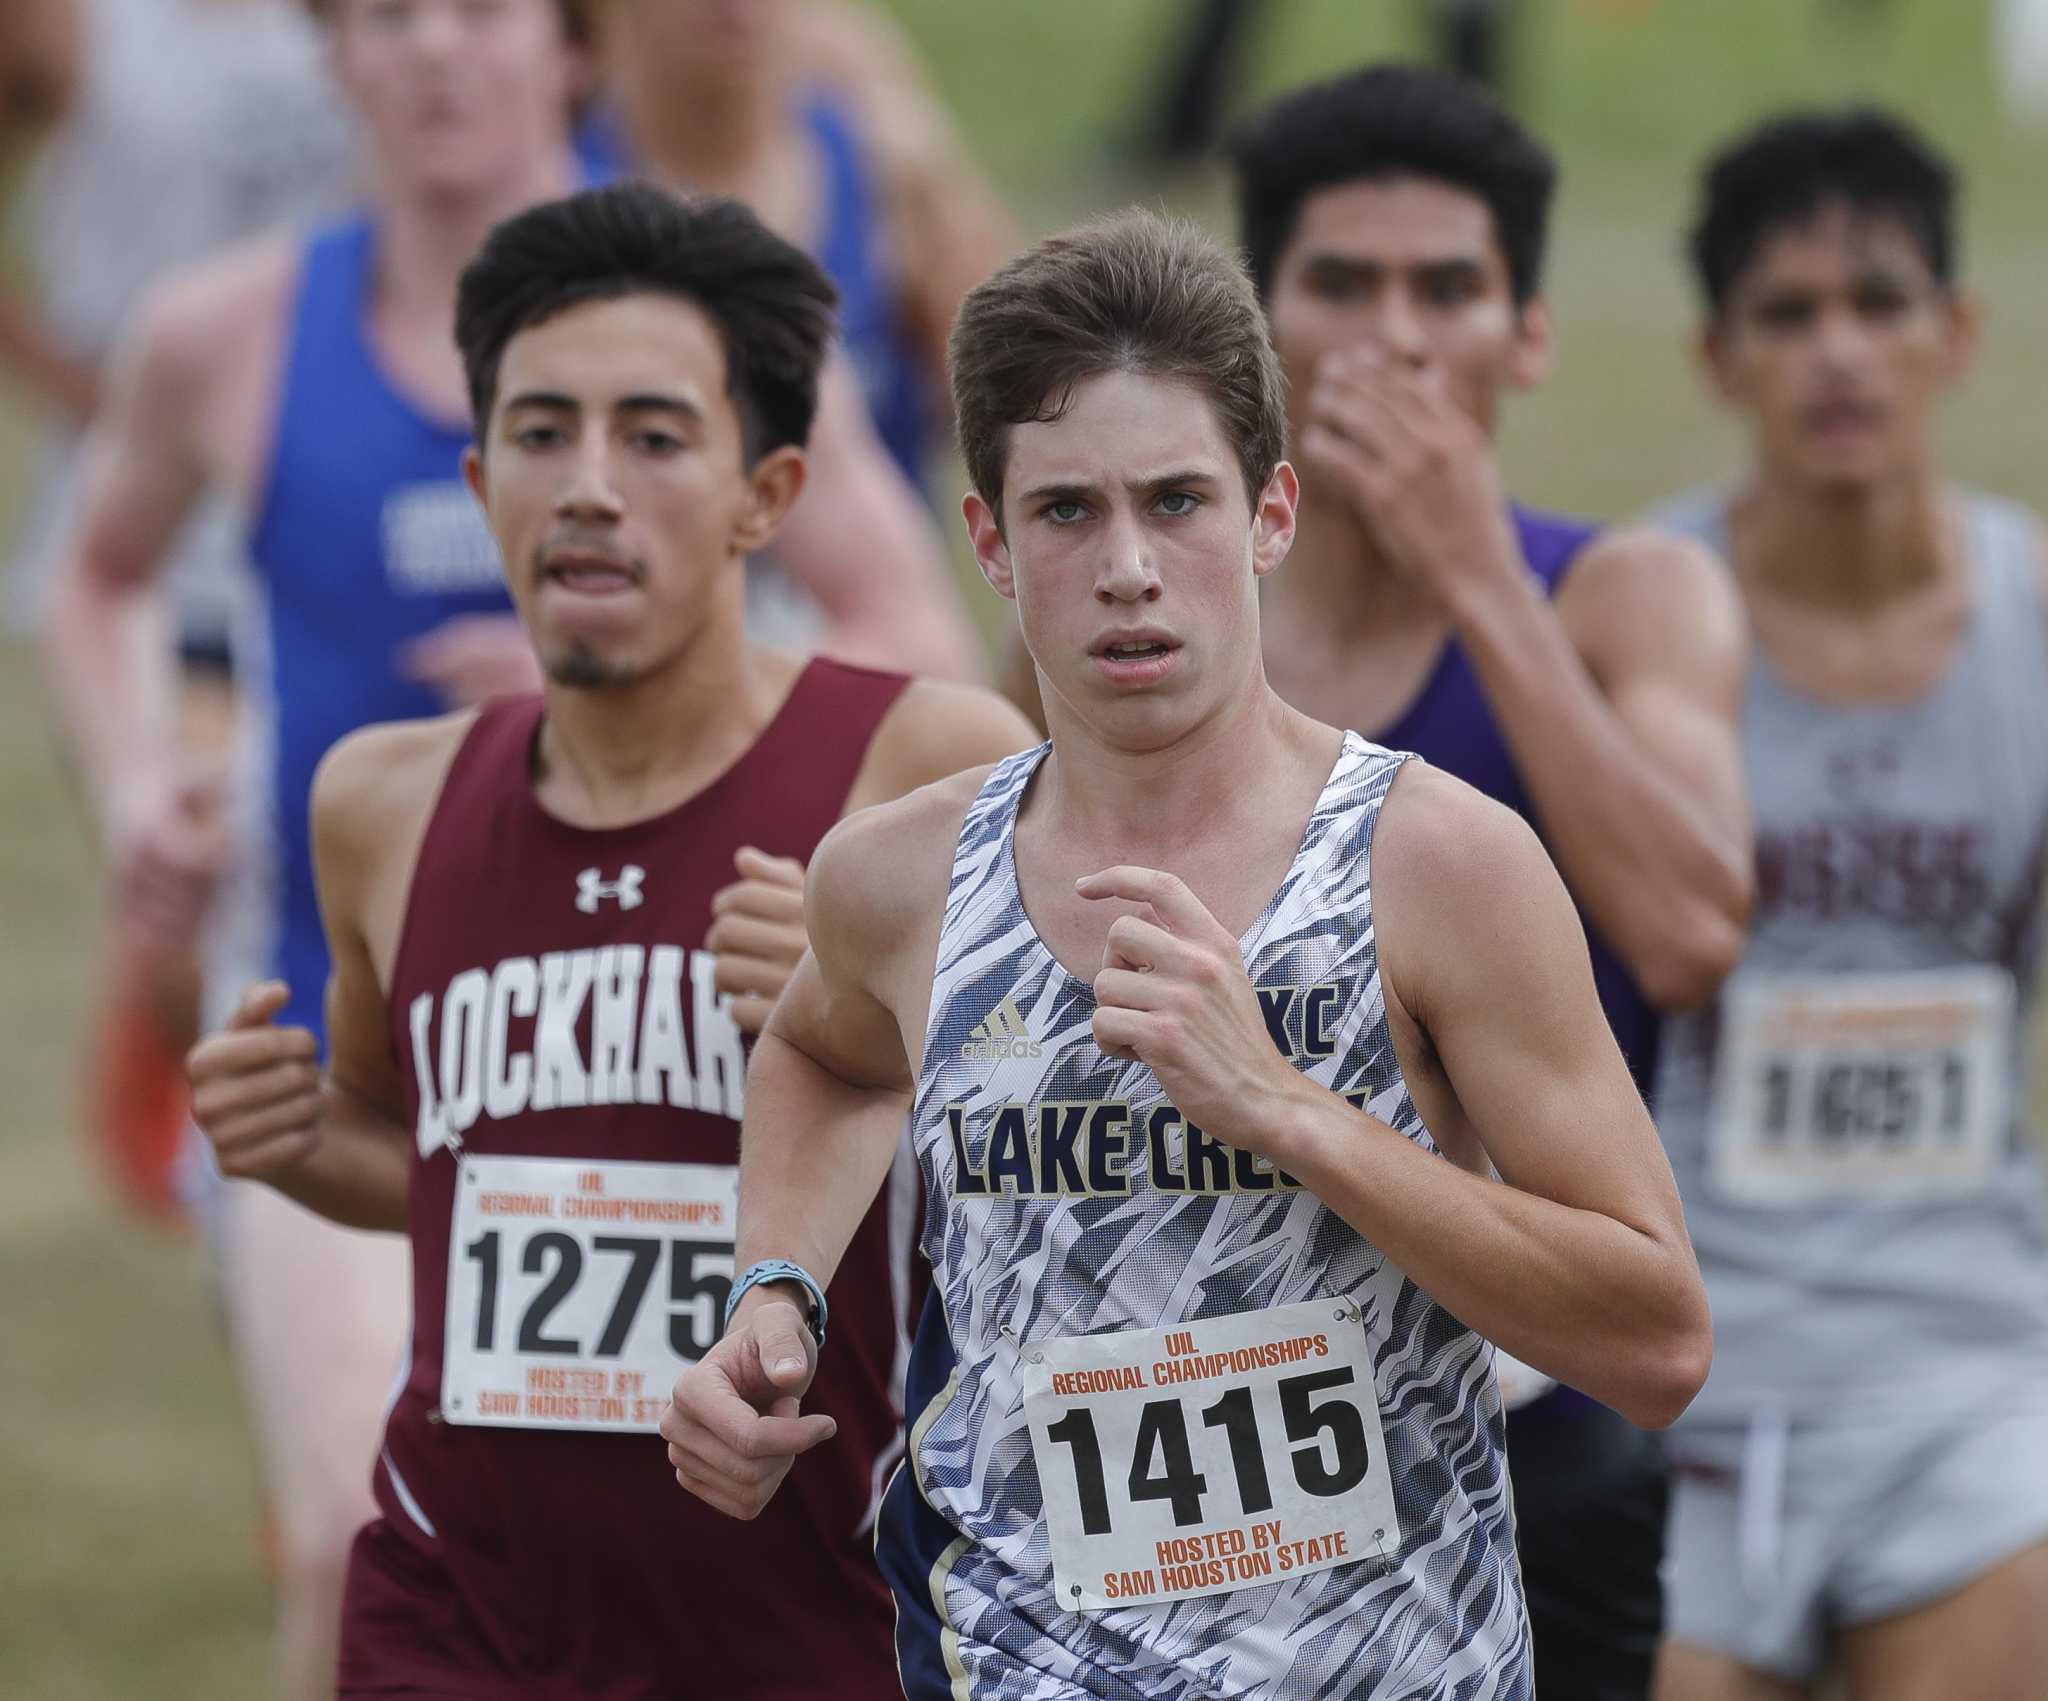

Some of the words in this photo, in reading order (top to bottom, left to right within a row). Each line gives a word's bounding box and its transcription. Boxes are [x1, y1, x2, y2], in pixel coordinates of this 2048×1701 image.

[409, 943, 745, 1159] LOCKHAR
[960, 1037, 1043, 1059] adidas
[1253, 983, 1339, 1060] XC
[948, 1101, 1131, 1196] LAKE
[480, 1192, 552, 1216] REGIONAL
[560, 1196, 723, 1225] CHAMPIONSHIPS
[467, 1231, 736, 1364] 1275
[1052, 1365, 1148, 1395] REGIONAL
[1152, 1334, 1329, 1386] CHAMPIONSHIPS
[1165, 1331, 1199, 1357] UIL
[479, 1391, 520, 1417] SAM
[527, 1394, 626, 1421] HOUSTON
[527, 1367, 608, 1393] HOSTED
[614, 1371, 645, 1393] BY
[1047, 1366, 1369, 1535] 1415
[1103, 1568, 1156, 1599] SAM
[1161, 1551, 1273, 1592] HOUSTON
[1278, 1531, 1349, 1570] STATE
[1155, 1528, 1246, 1566] HOSTED
[1251, 1520, 1283, 1549] BY
